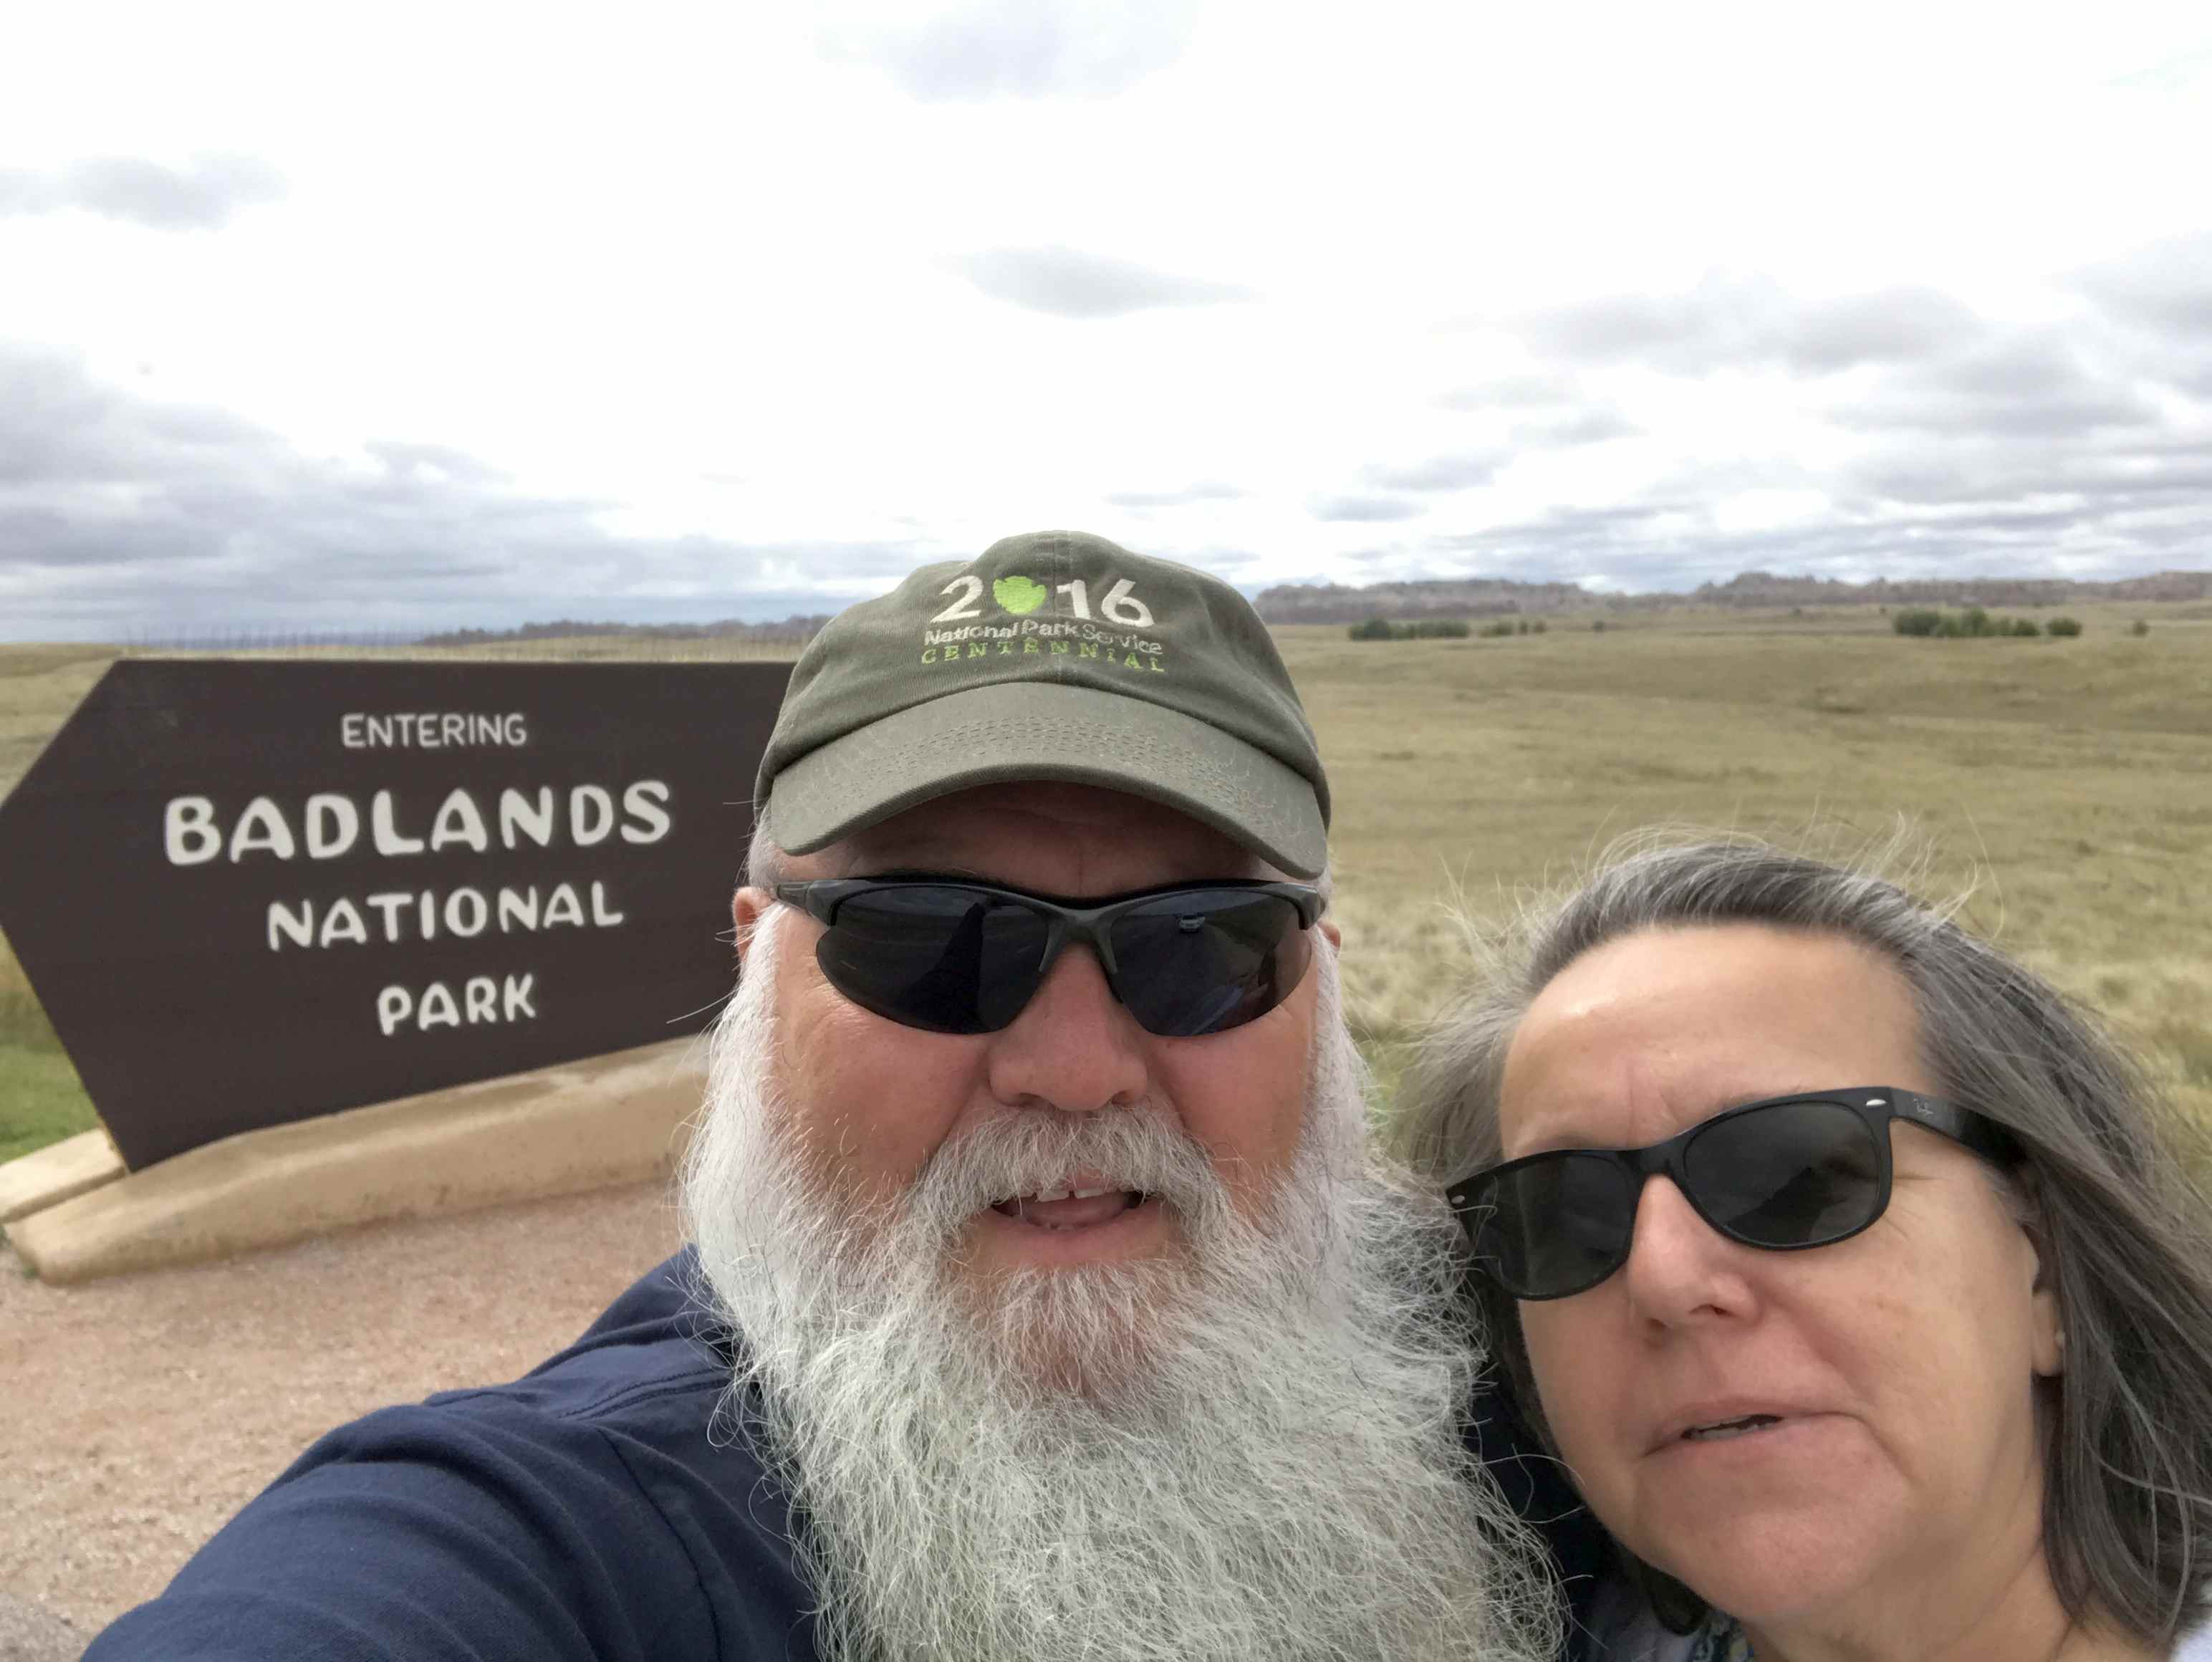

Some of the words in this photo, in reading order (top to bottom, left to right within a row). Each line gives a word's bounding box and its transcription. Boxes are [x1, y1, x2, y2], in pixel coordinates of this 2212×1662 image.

[921, 638, 1164, 672] CENTENNIAL
[924, 622, 1019, 645] National
[1021, 619, 1076, 637] Park
[1082, 623, 1163, 655] Service
[342, 714, 528, 749] ENTERING
[164, 780, 672, 866] BADLANDS
[267, 880, 625, 951] NATIONAL
[377, 972, 537, 1037] PARK
